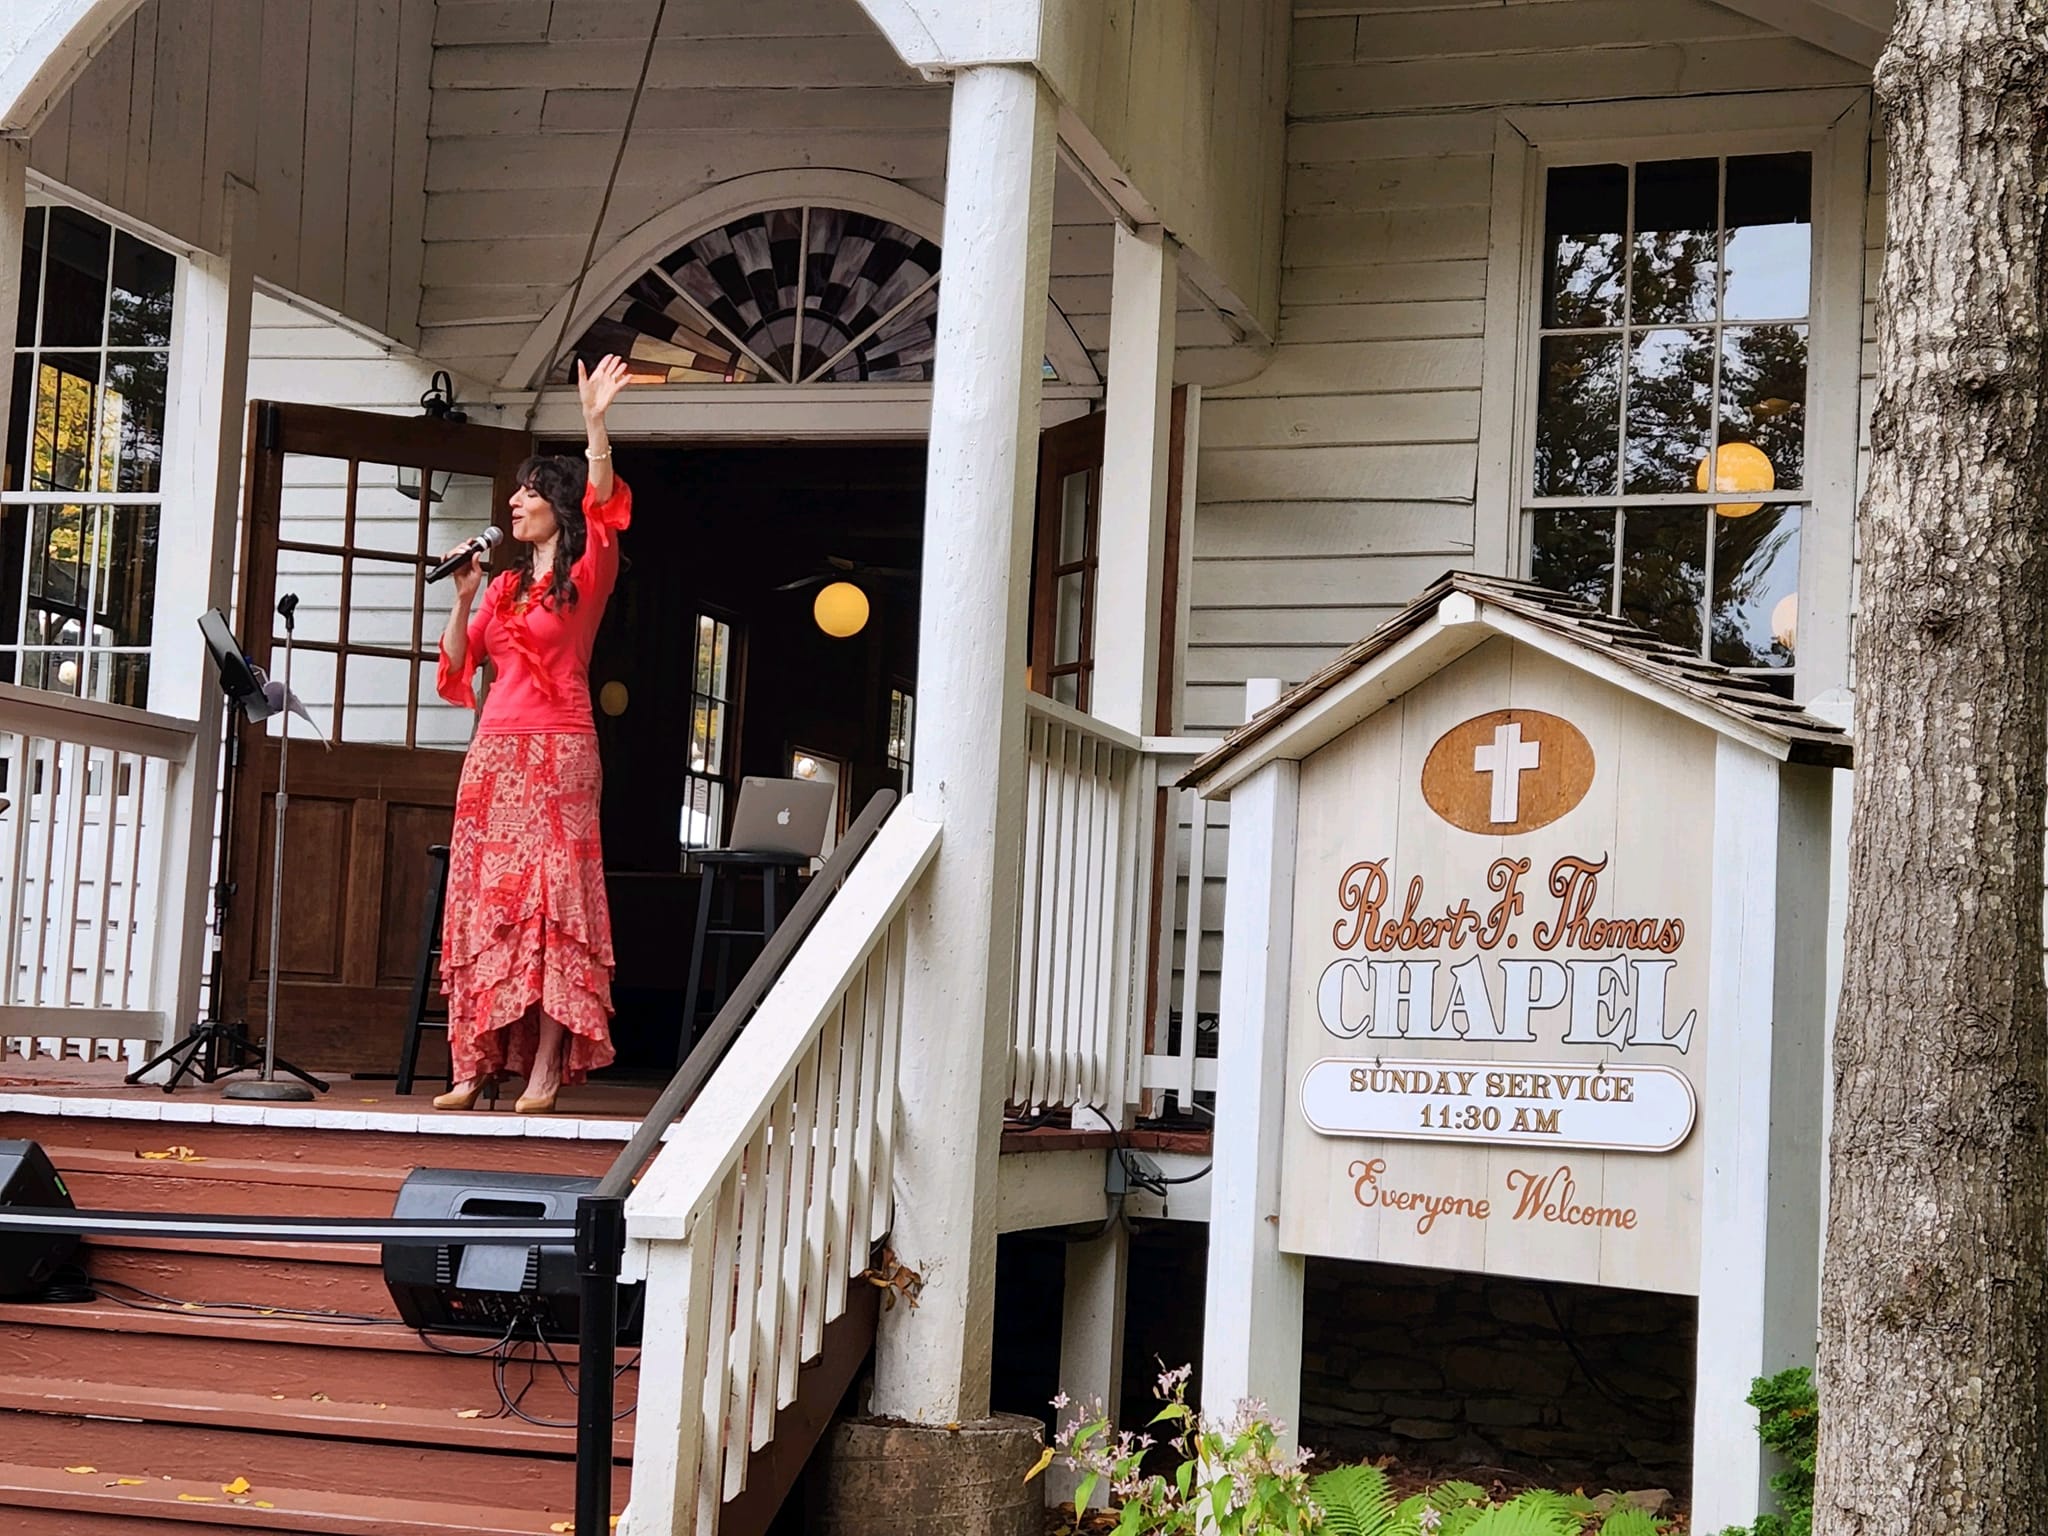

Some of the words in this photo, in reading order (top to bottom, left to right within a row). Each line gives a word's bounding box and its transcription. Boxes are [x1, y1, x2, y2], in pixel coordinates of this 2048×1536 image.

[1333, 857, 1479, 952] Robert
[1478, 857, 1531, 948] F.
[1534, 851, 1685, 953] Thomas
[1317, 954, 1697, 1054] CHAPEL
[1349, 1068, 1478, 1096] SUNDAY
[1485, 1072, 1634, 1103] SERVICE
[1420, 1104, 1501, 1131] 11:30
[1509, 1107, 1563, 1134] AM
[1348, 1158, 1490, 1234] Everyone
[1507, 1166, 1637, 1229] Welcome
